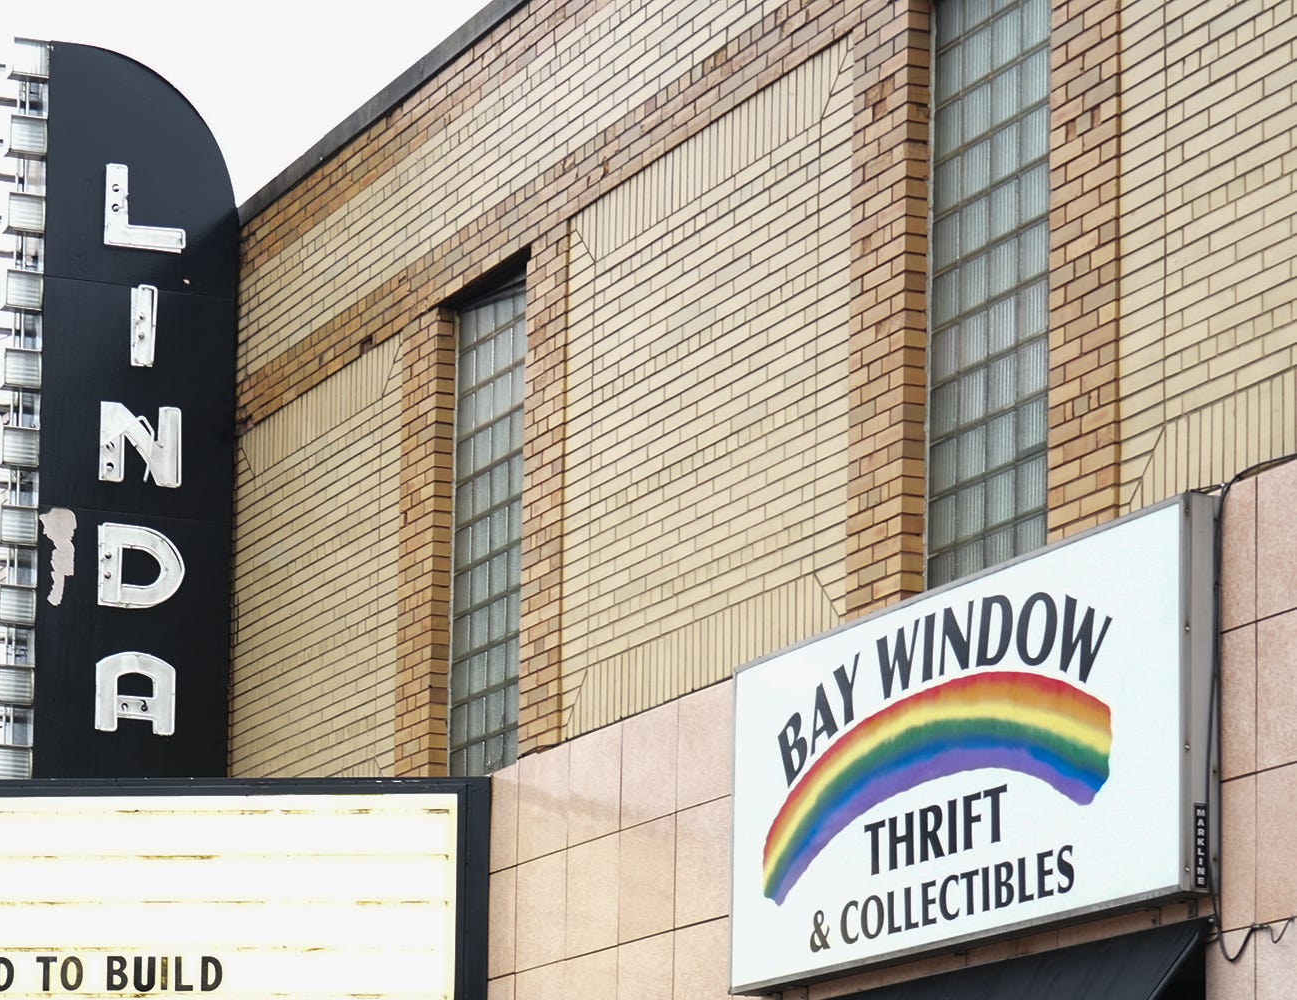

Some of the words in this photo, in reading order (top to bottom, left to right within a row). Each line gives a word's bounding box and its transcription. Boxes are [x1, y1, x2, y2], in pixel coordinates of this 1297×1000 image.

[94, 162, 187, 737] LINDA
[777, 651, 861, 788] BAY
[876, 591, 1113, 700] WINDOW
[864, 783, 1008, 876] THRIFT
[1196, 808, 1206, 885] MARKLINE
[810, 909, 831, 953] &
[839, 844, 1075, 945] COLLECTIBLES
[36, 955, 84, 992] TO
[105, 954, 224, 992] BUILD
